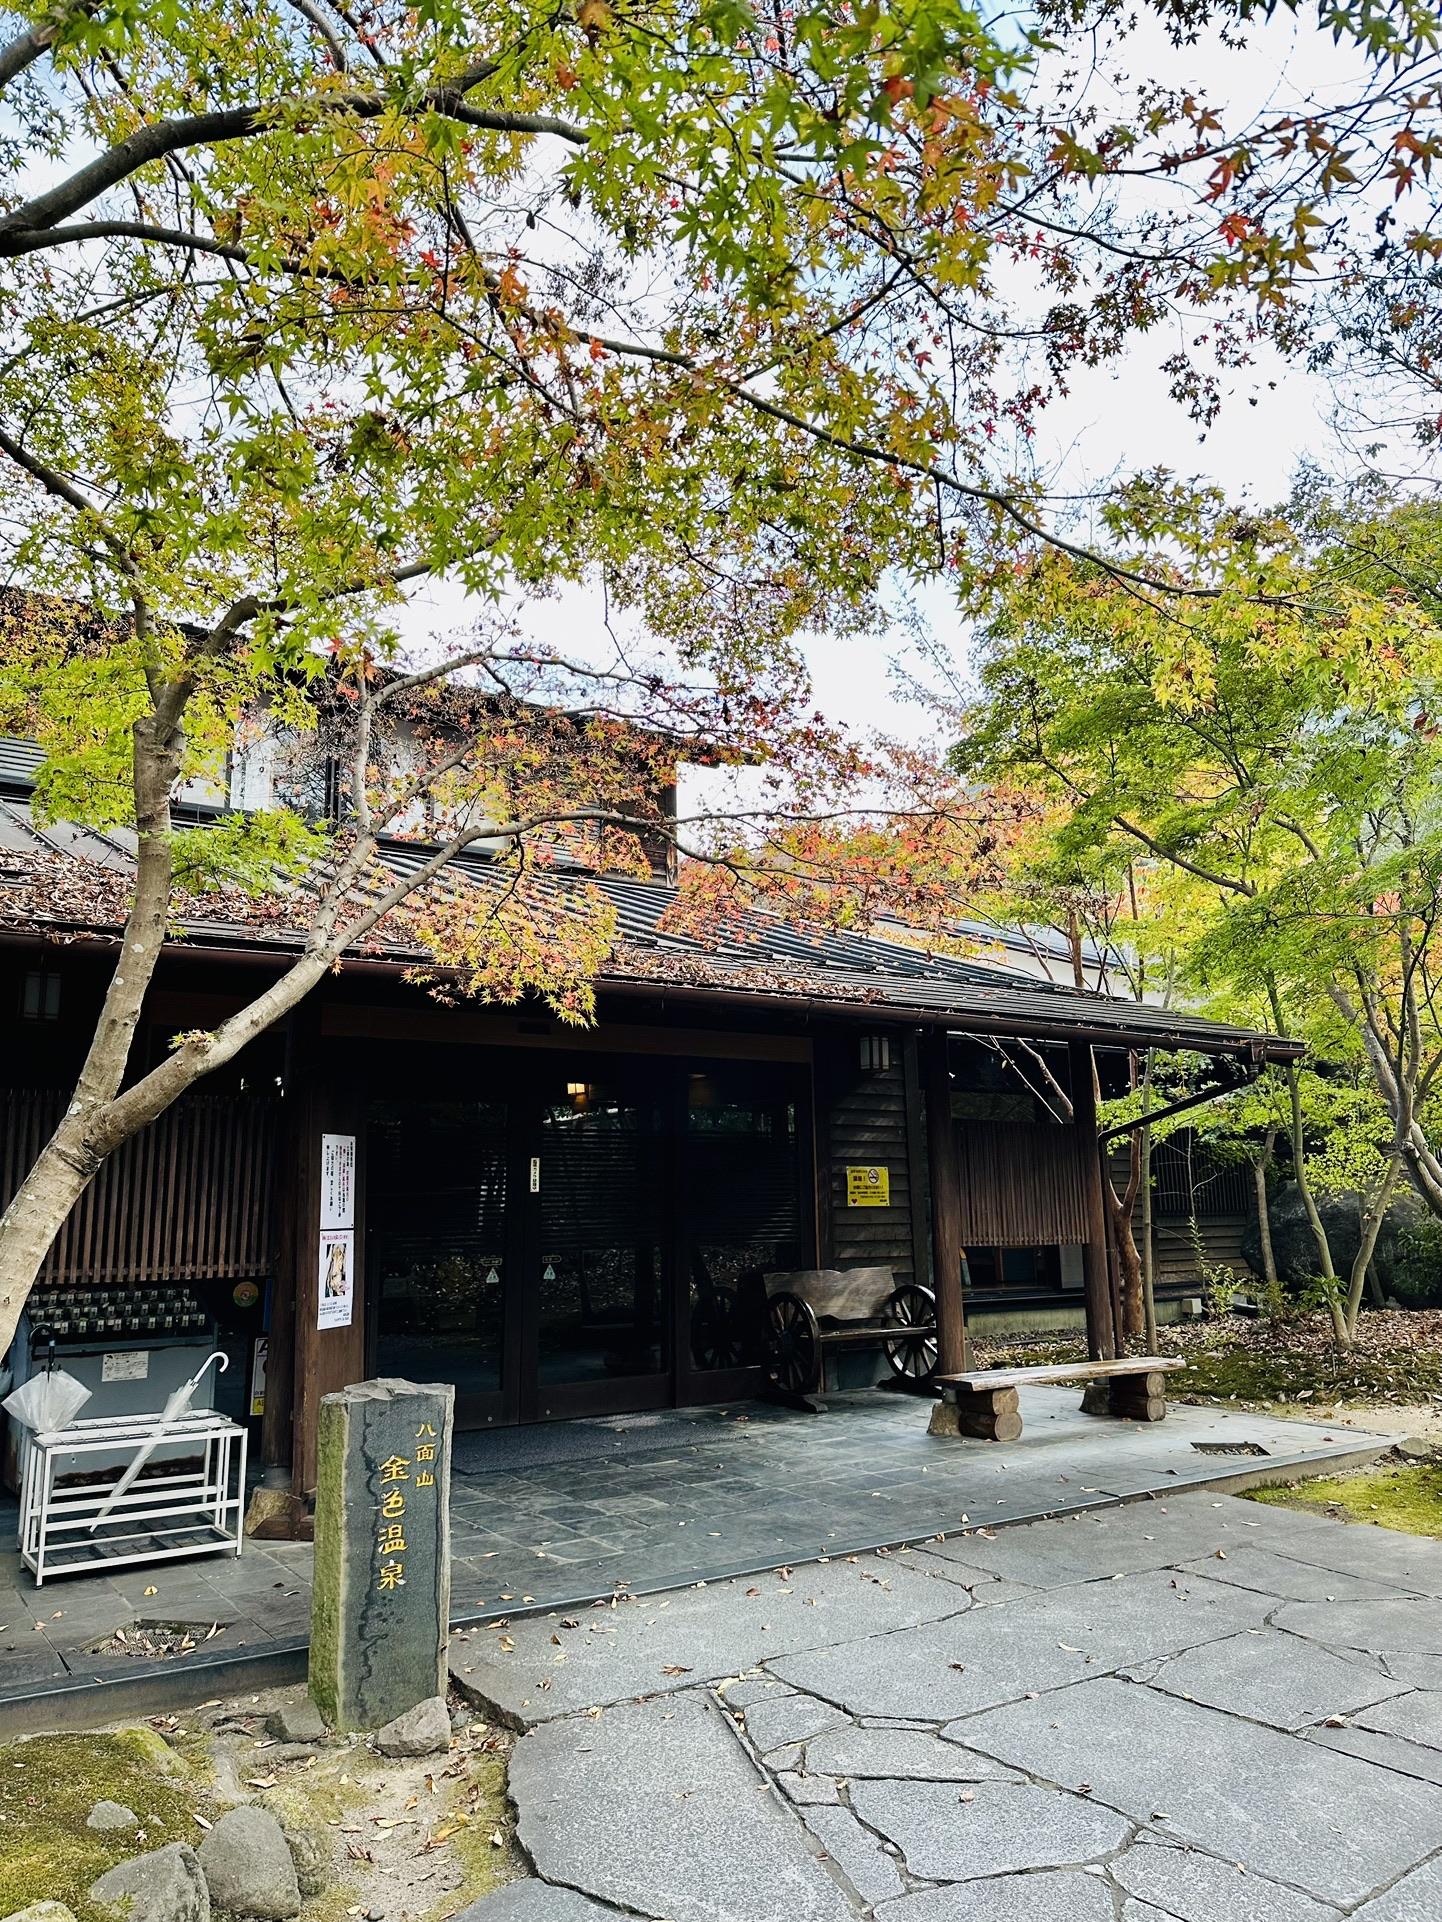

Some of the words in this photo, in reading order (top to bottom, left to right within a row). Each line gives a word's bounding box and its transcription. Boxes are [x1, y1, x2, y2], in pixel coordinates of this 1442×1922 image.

[415, 1420, 437, 1487] 八面山
[377, 1456, 410, 1590] 金色温泉
